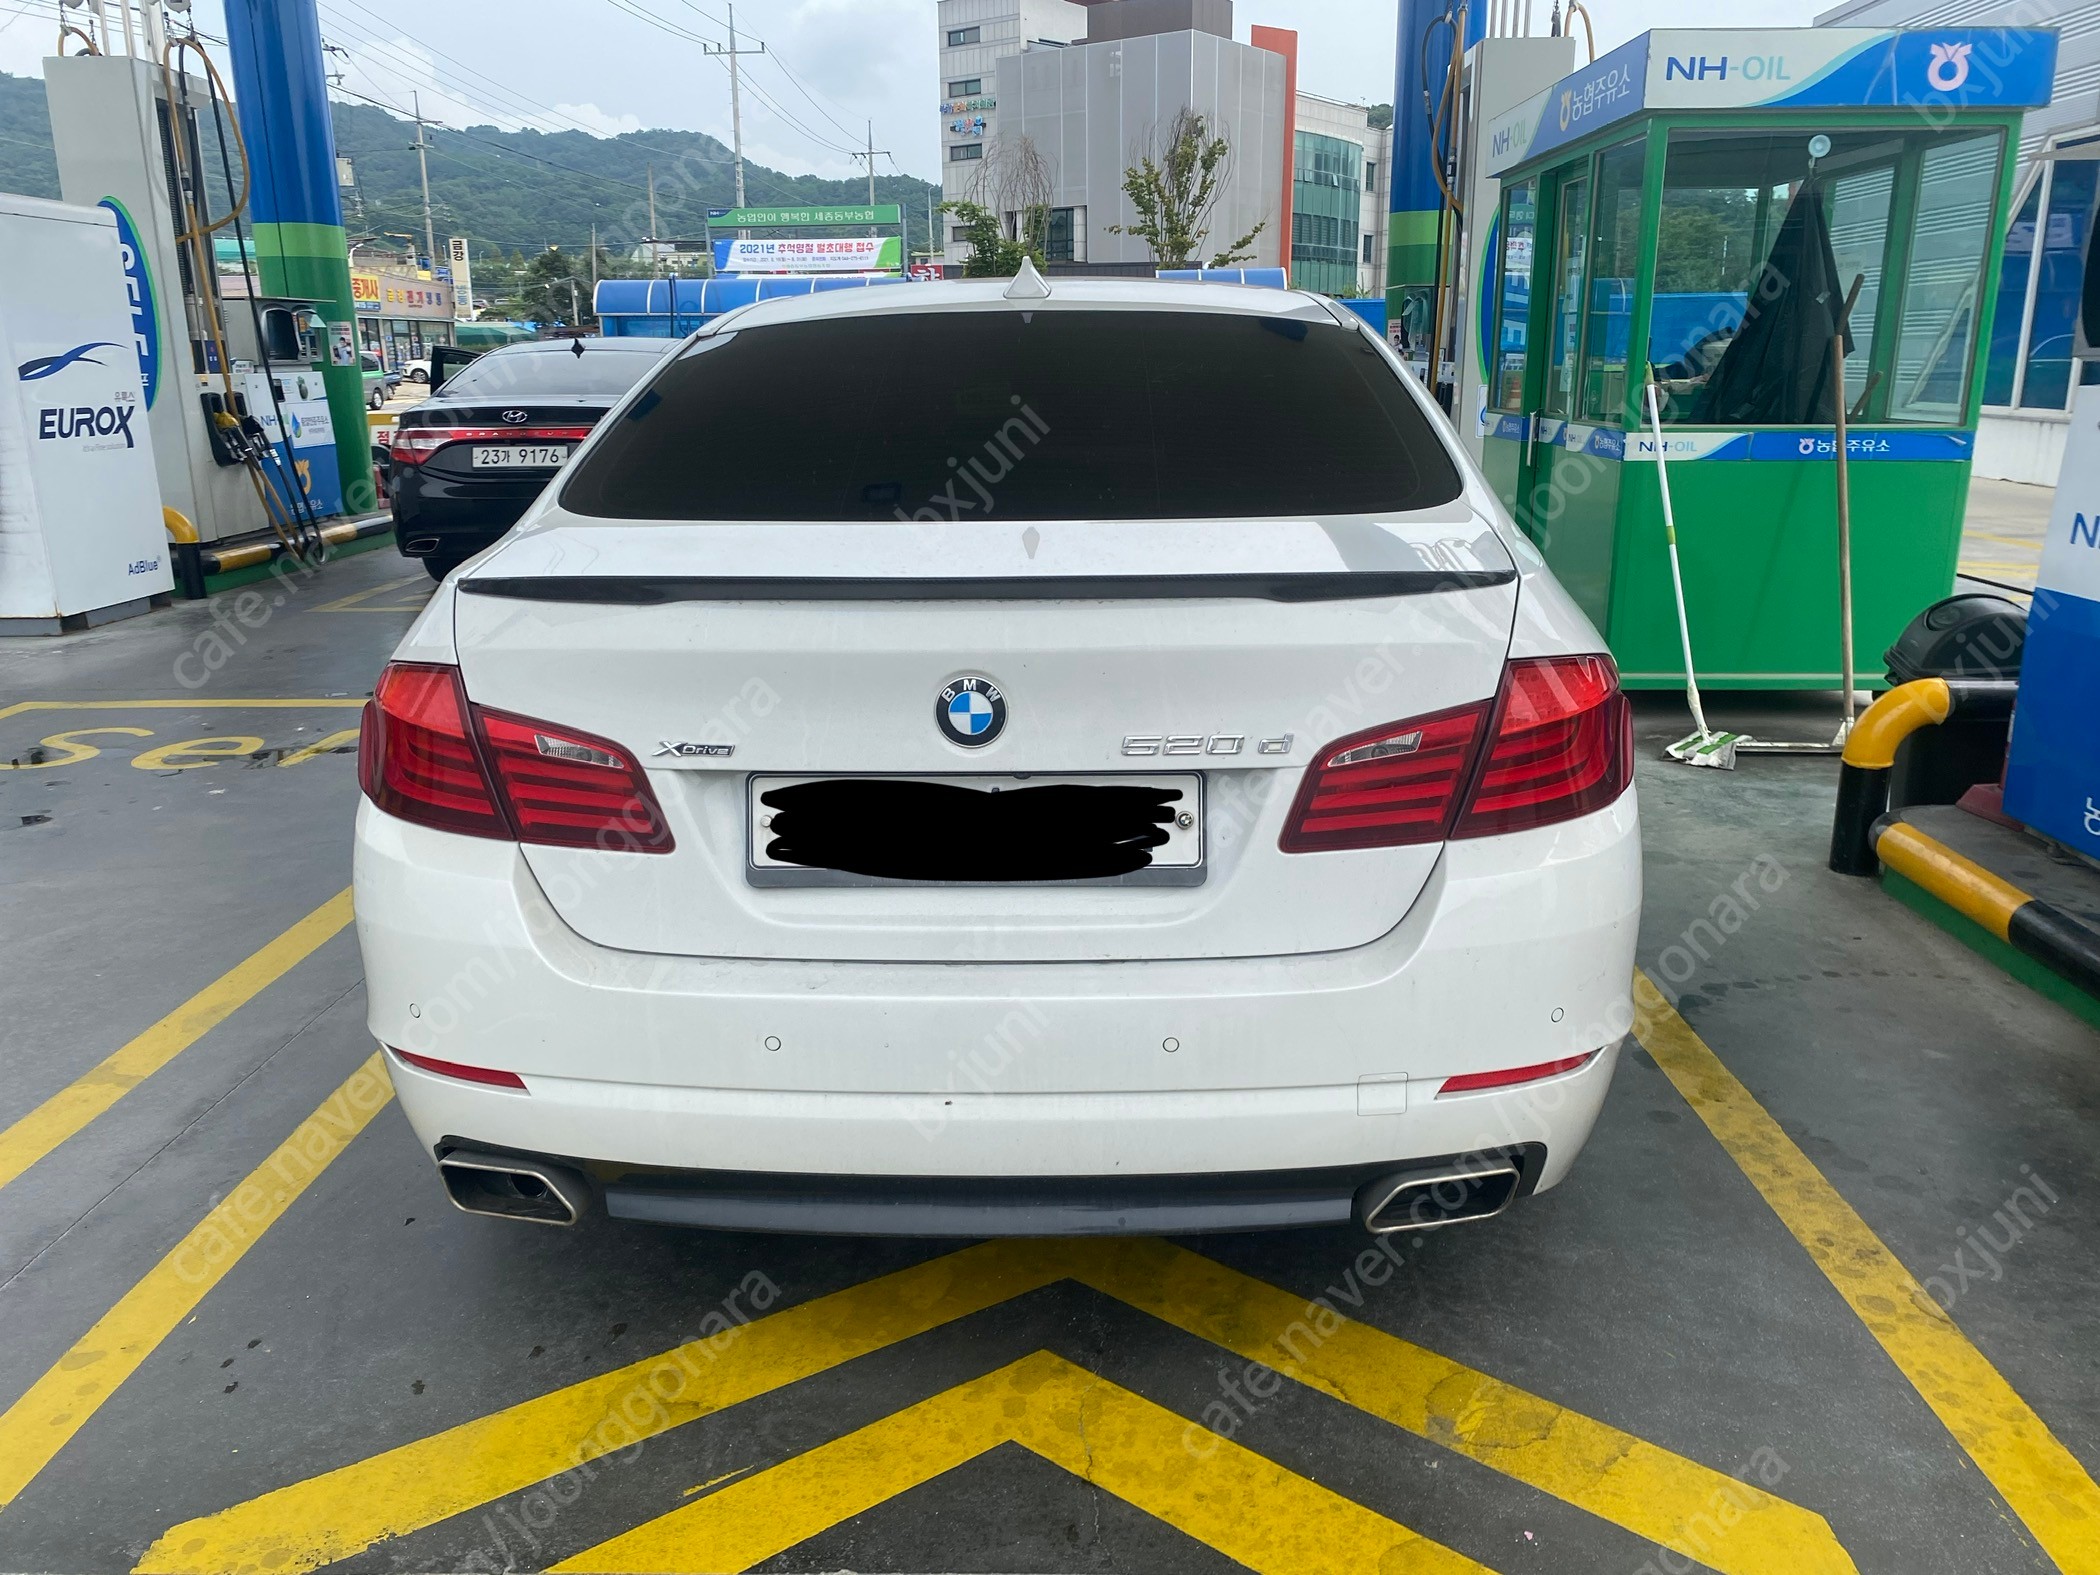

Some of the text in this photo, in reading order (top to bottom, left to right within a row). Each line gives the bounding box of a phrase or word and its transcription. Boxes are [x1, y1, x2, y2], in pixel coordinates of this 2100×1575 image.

[1665, 56, 1791, 81] NH-OIL
[1572, 63, 1631, 121] 농협주유소
[1492, 117, 1527, 158] NH-OIL
[780, 211, 810, 222] 행복한
[452, 240, 464, 261] 금강
[740, 242, 775, 254] 2021년
[777, 242, 814, 254] 추석명절
[856, 241, 875, 253] 접수
[39, 405, 135, 449] EUROX
[481, 448, 559, 464] 23가 9176
[2070, 512, 2100, 549] N
[941, 679, 1000, 702] BMW
[1121, 733, 1294, 756] 520 d
